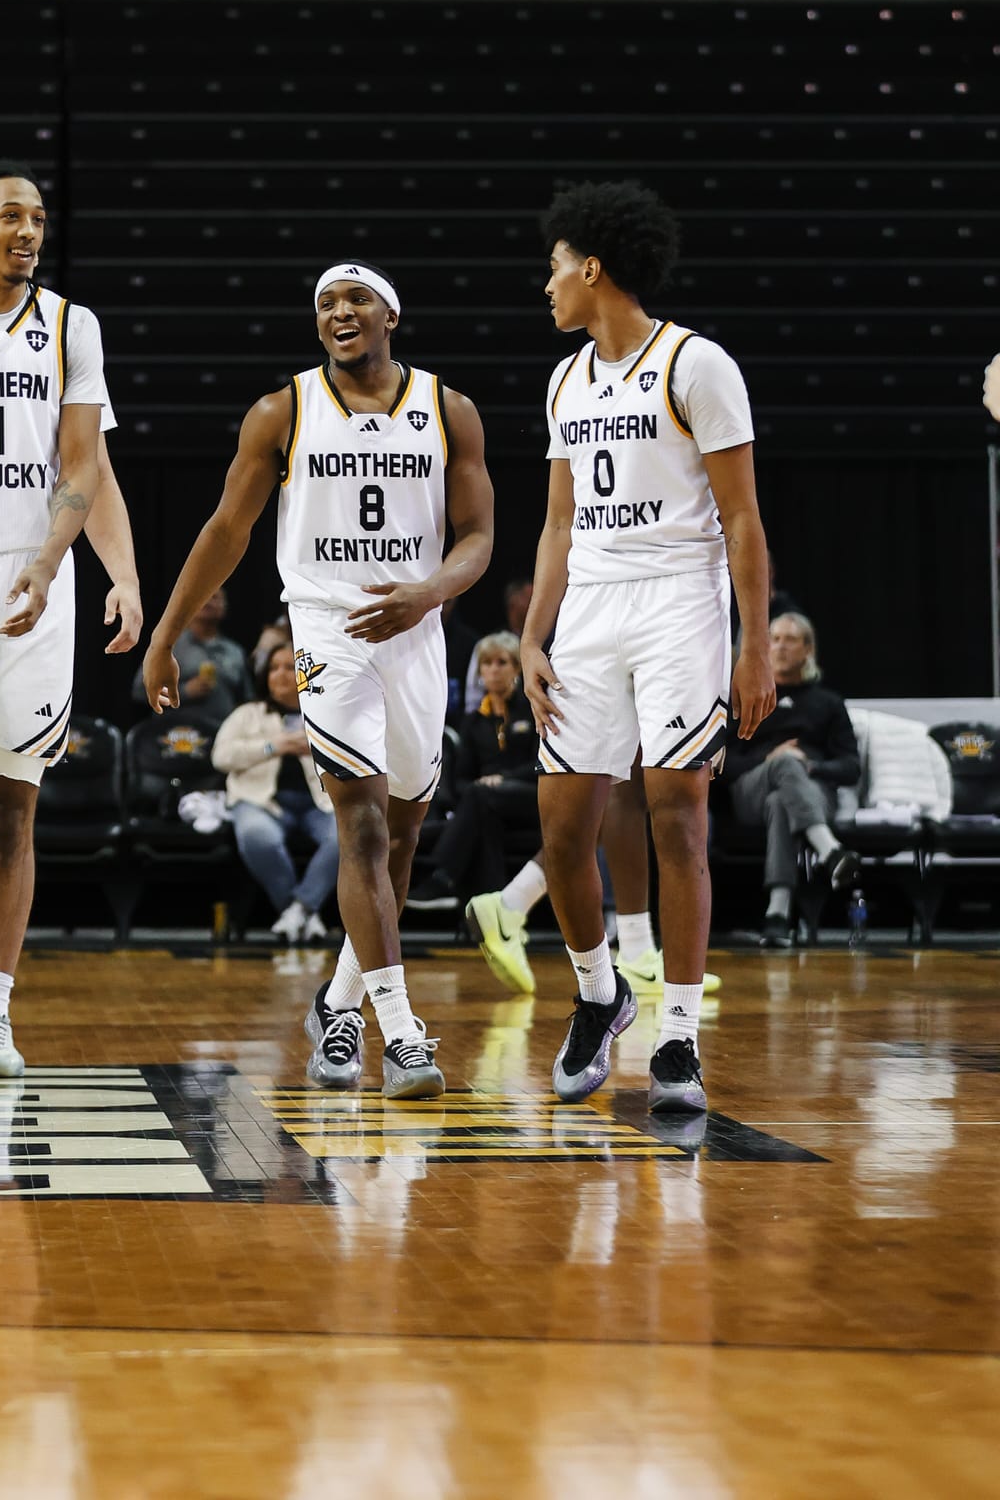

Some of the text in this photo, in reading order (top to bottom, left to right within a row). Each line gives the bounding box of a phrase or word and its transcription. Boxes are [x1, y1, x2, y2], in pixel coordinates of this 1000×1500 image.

[559, 413, 658, 447] NORTHERN
[308, 452, 432, 478] NORTHERN
[593, 449, 616, 497] 0
[359, 484, 385, 532] 8
[314, 535, 424, 562] KENTUCKY
